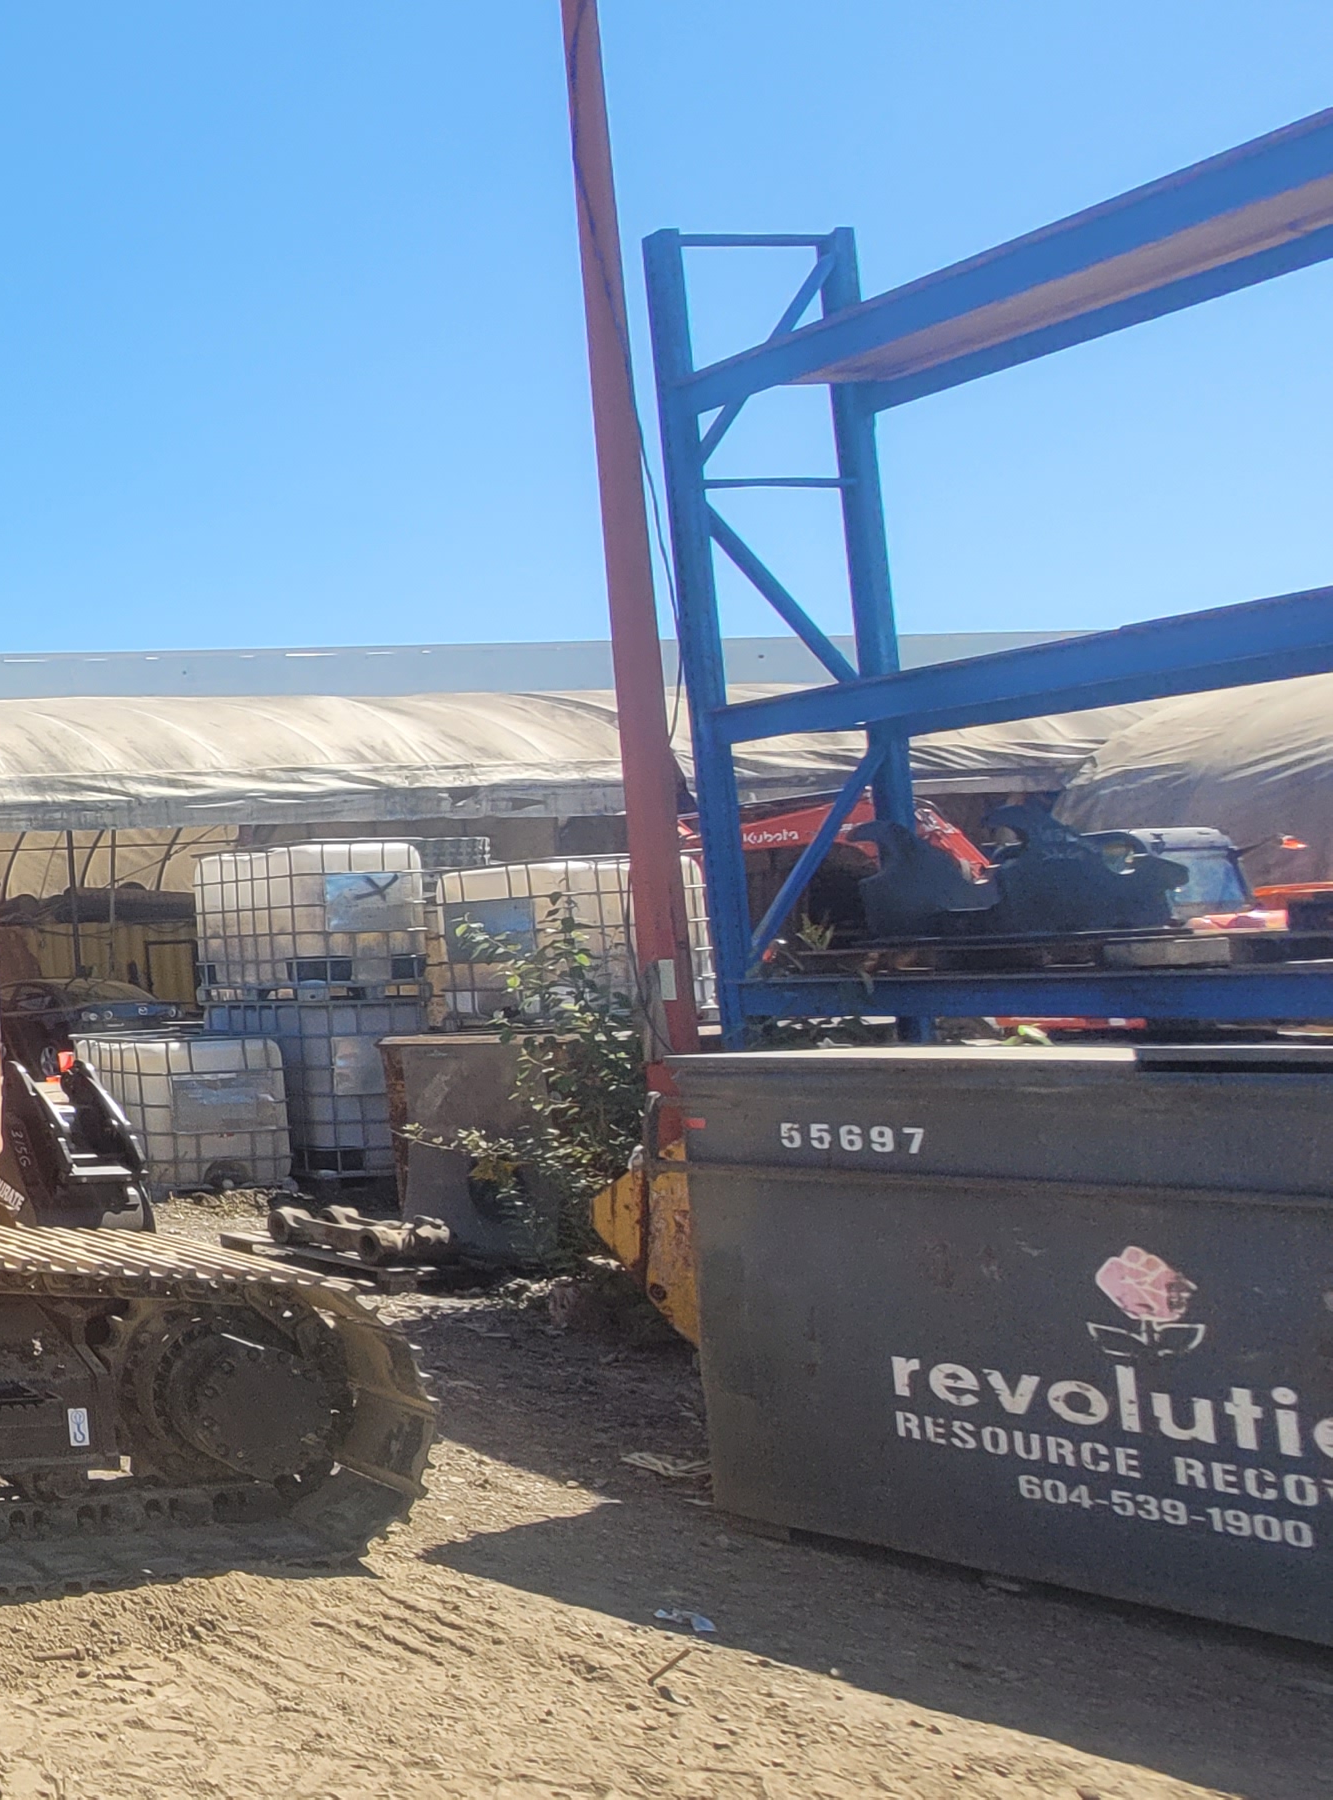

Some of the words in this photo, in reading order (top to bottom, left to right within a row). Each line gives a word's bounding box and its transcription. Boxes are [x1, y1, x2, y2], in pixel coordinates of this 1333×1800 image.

[743, 829, 799, 844] Kubota
[780, 1122, 926, 1155] 55697
[895, 1410, 1142, 1479] RESOURCE
[1017, 1474, 1315, 1549] 604-539-1900
